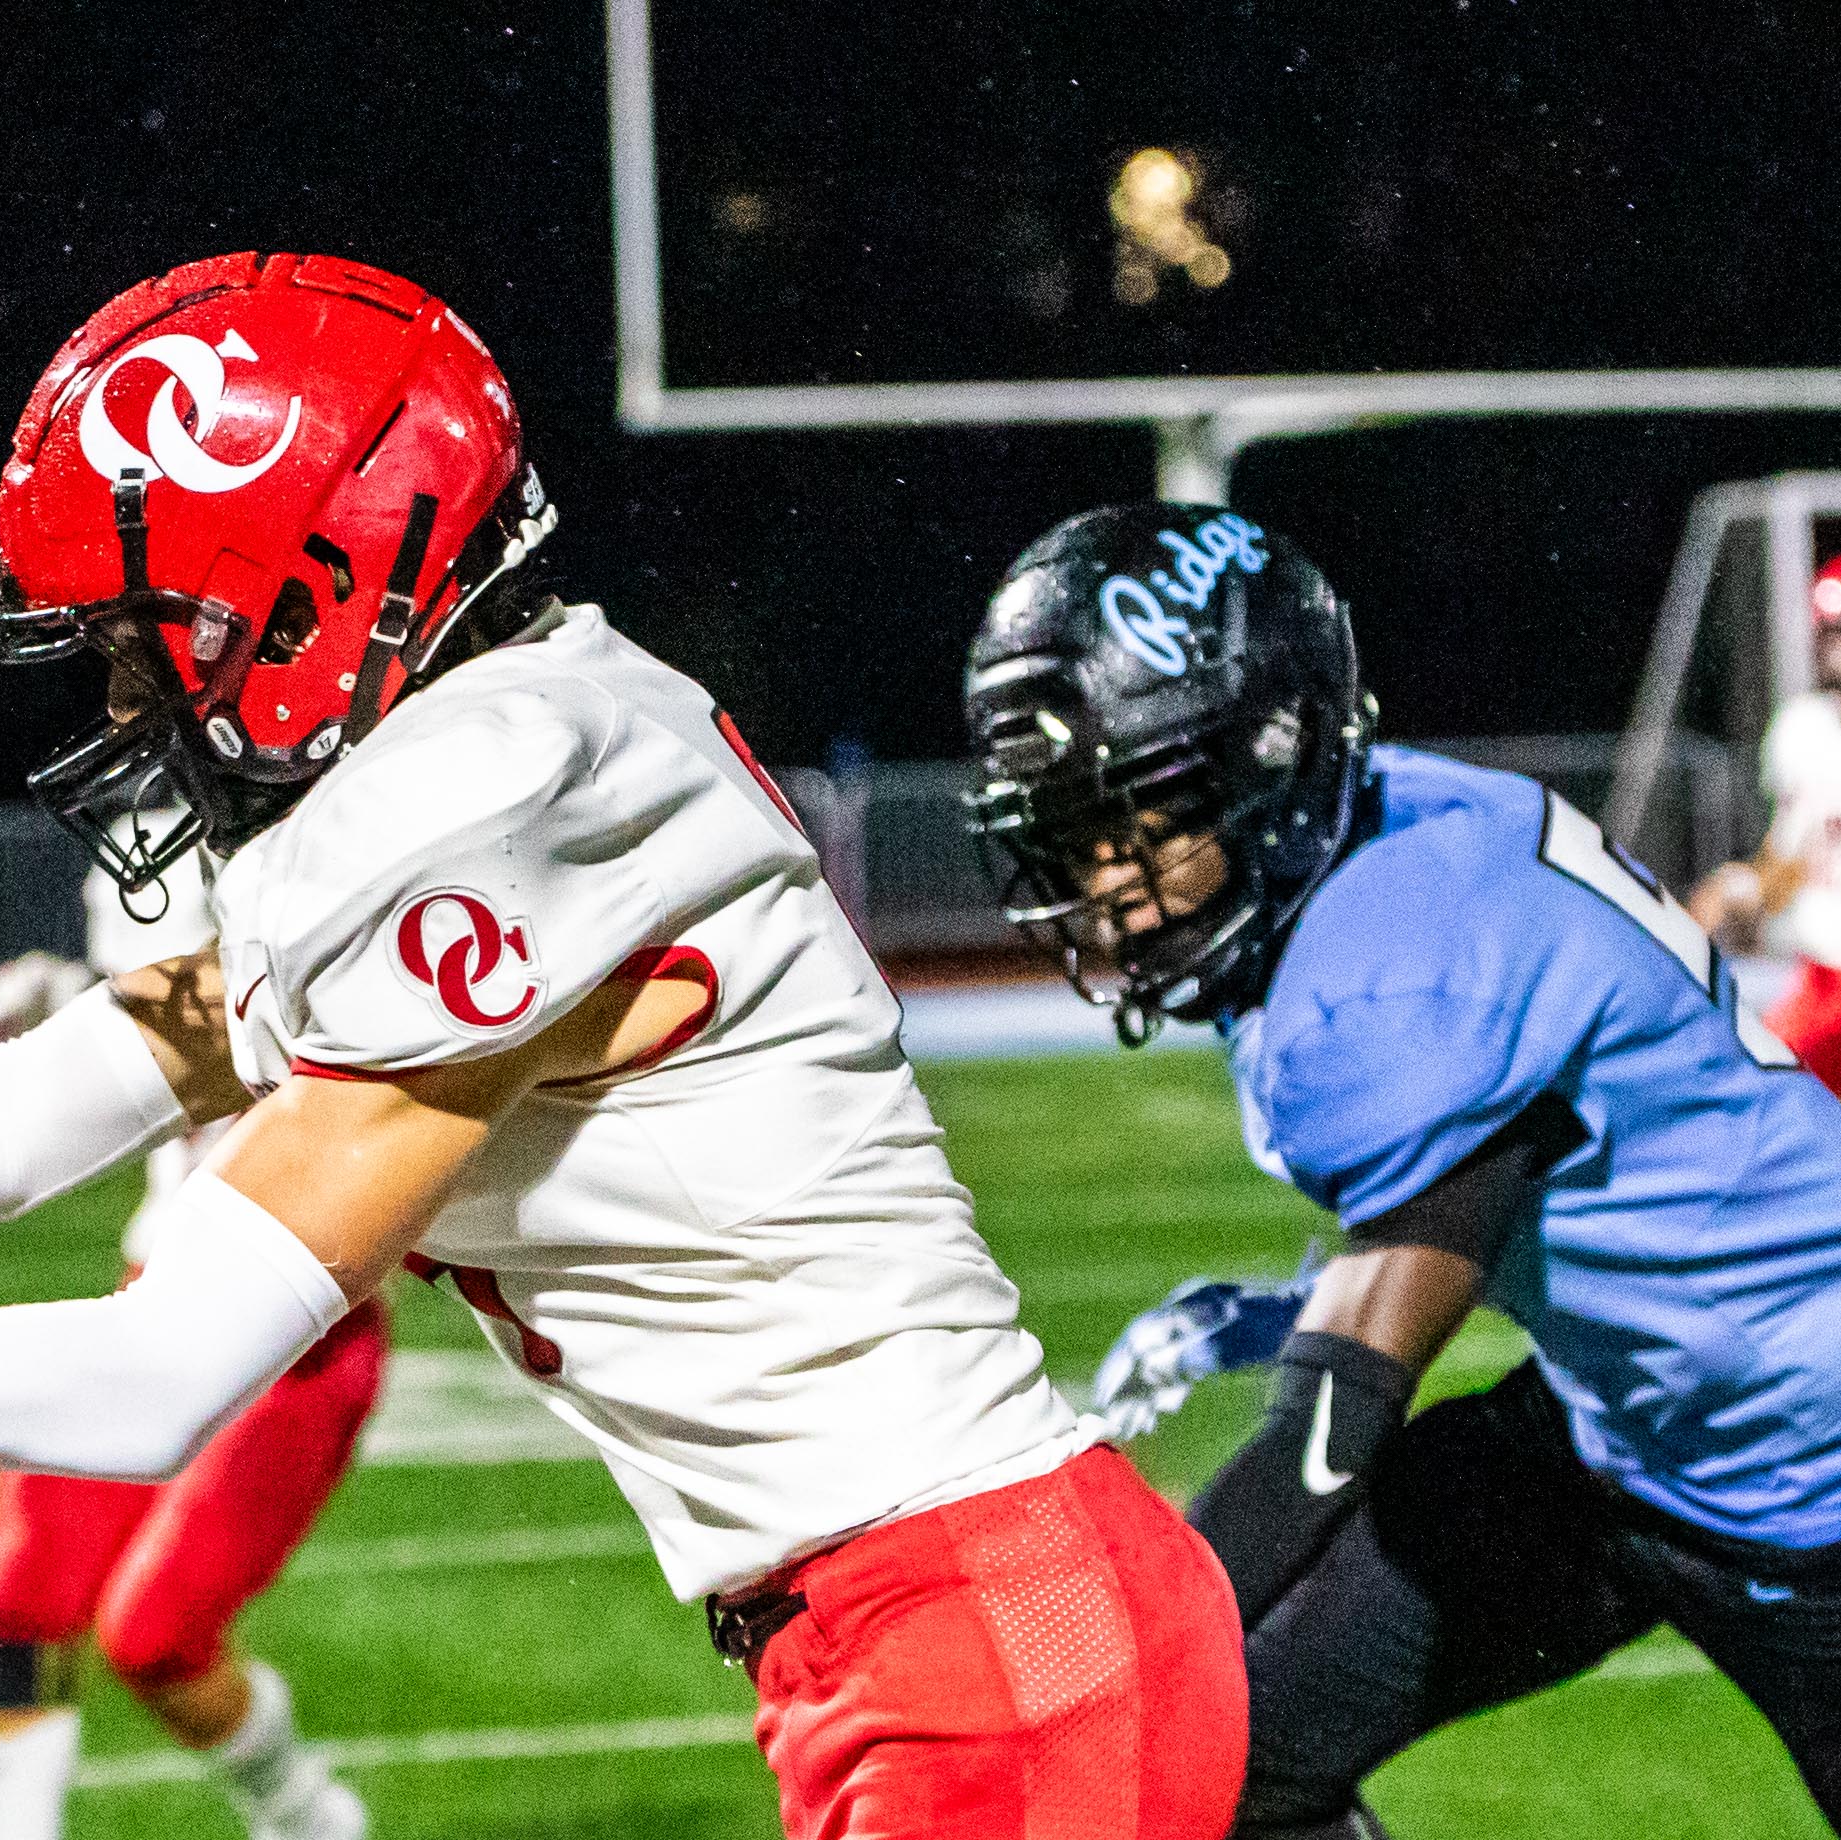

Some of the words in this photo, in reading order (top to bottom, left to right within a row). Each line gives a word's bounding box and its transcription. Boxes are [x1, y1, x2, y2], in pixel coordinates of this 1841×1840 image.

[79, 328, 302, 494] OC
[1099, 512, 1265, 677] Ridge
[397, 892, 537, 1027] OC
